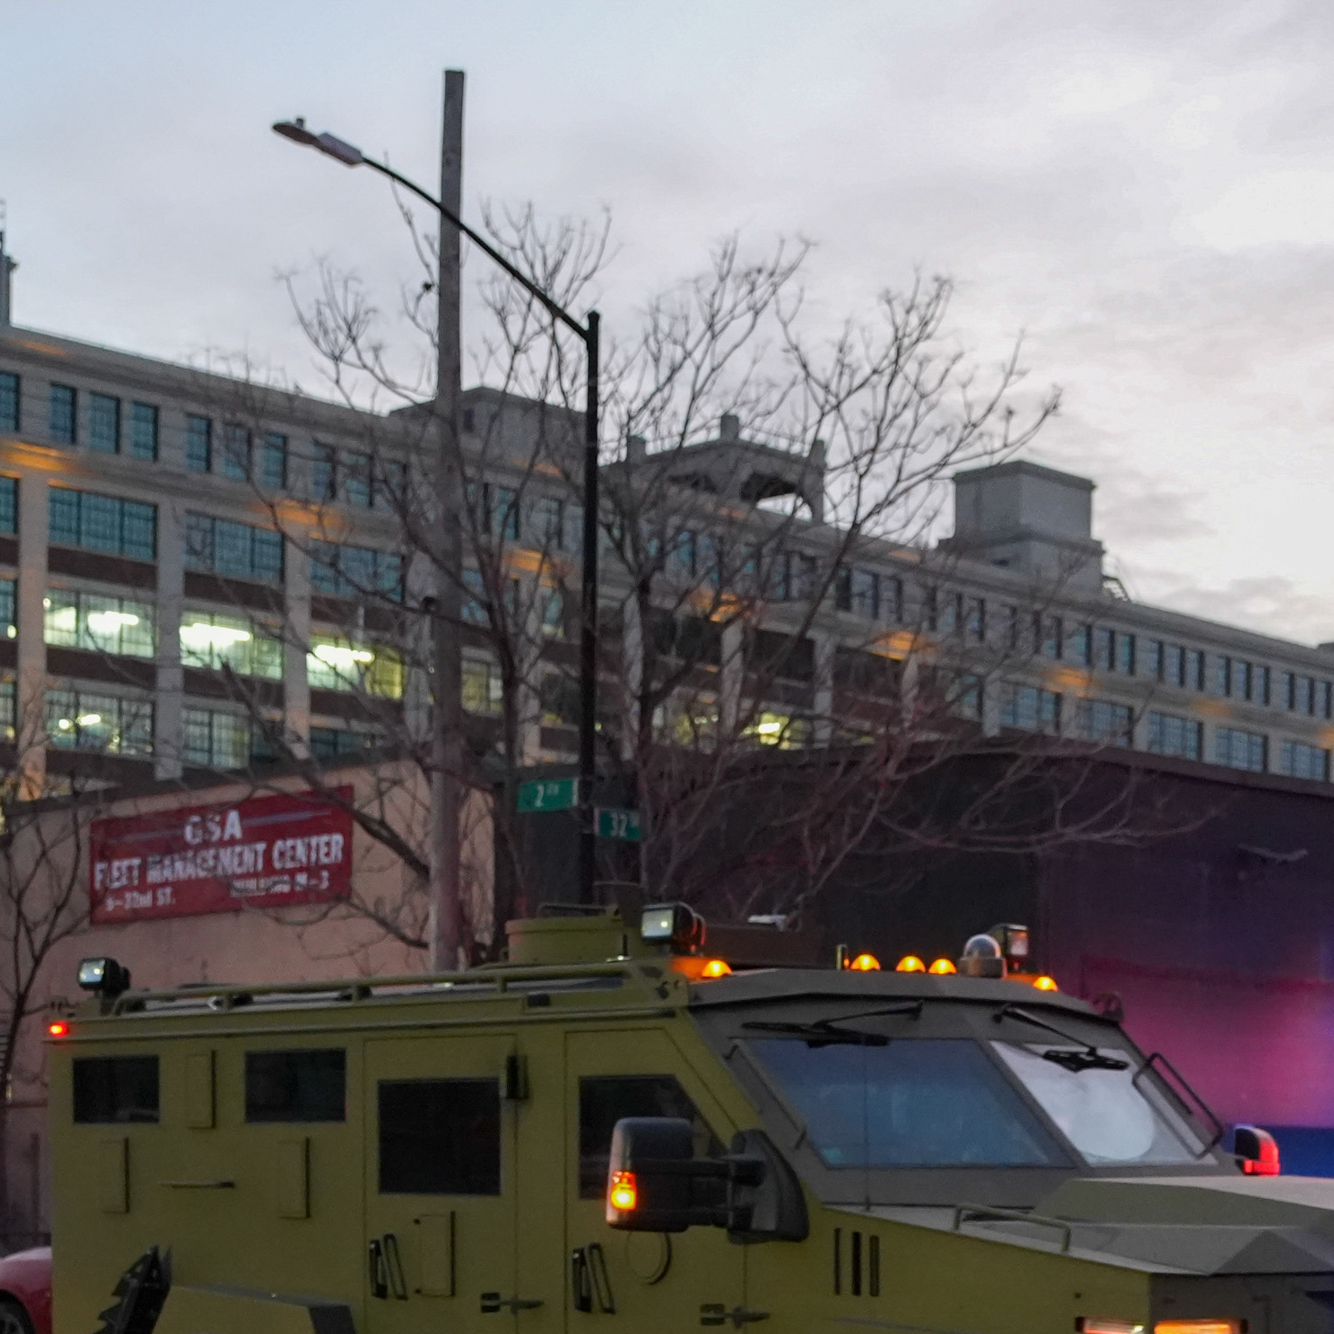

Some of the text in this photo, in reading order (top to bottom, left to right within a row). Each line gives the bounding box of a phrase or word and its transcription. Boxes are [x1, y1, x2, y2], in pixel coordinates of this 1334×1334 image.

[534, 784, 545, 808] 2
[184, 810, 243, 845] GSA
[610, 812, 627, 838] 32
[94, 833, 345, 891] FLEET MANAGEMENT CENTER
